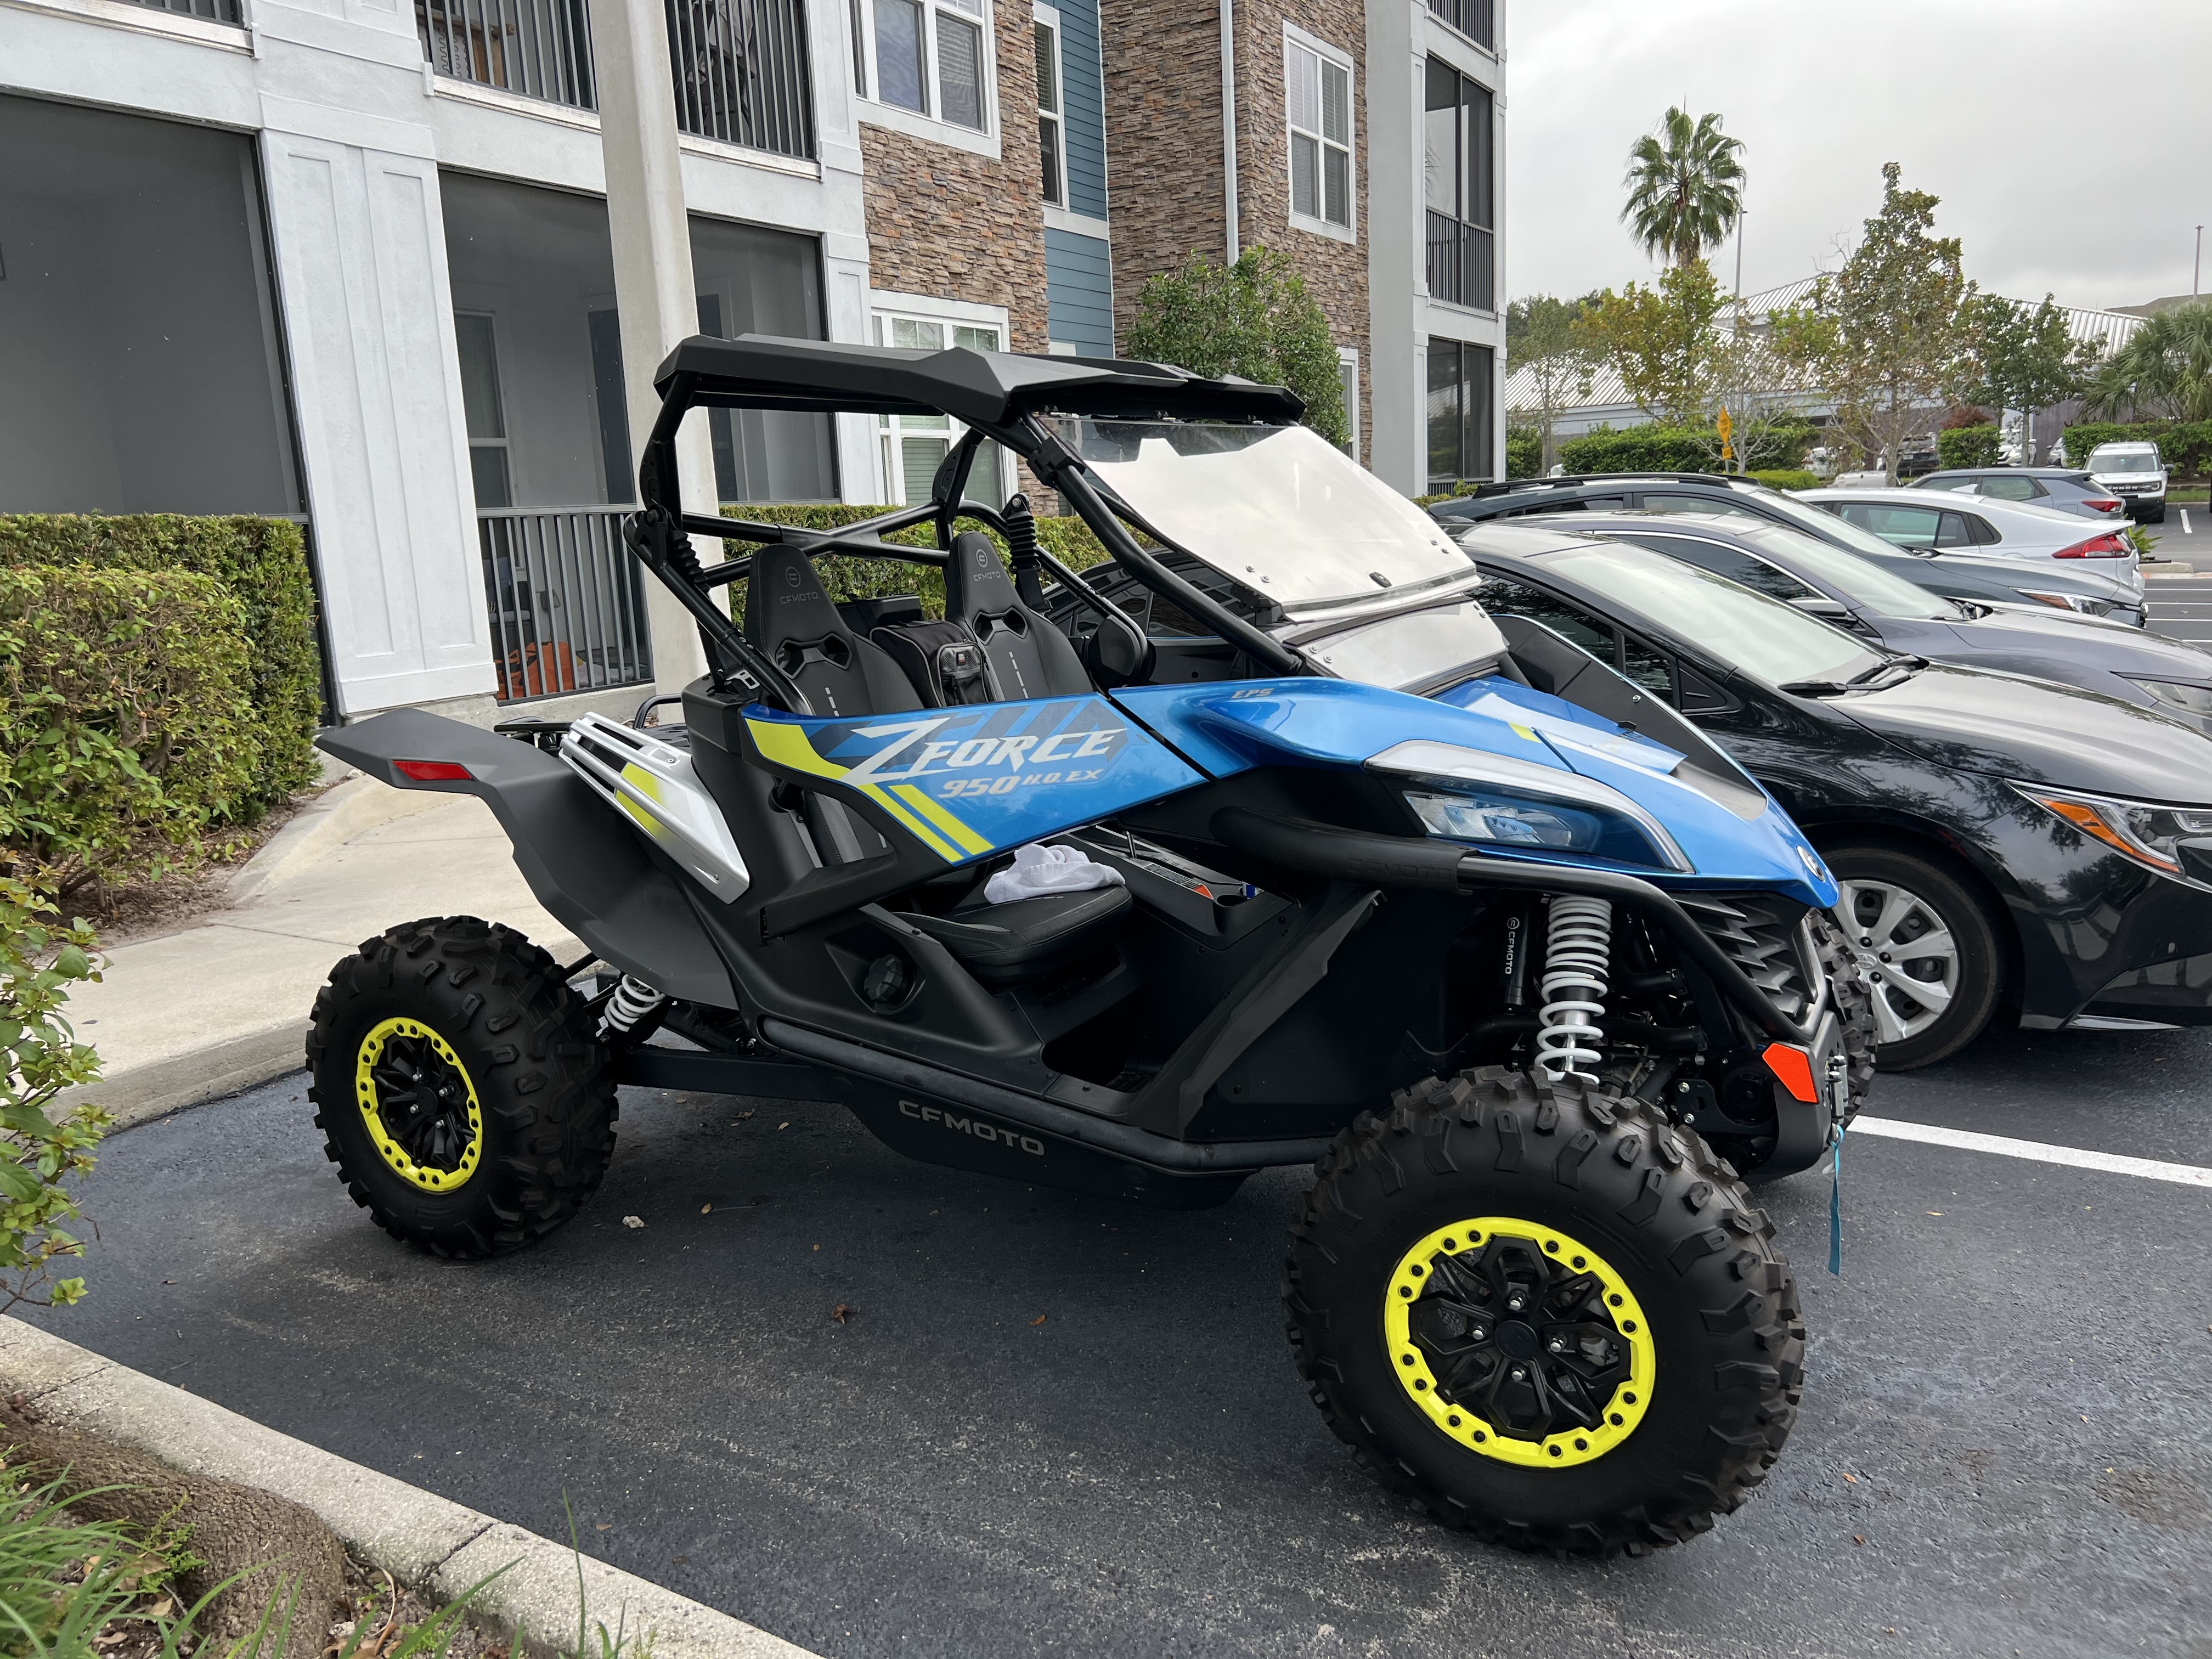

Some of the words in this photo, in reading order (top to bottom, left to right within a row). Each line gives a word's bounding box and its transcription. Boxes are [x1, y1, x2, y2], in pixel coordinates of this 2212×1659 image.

[973, 571, 1001, 582] CFMOTO
[780, 591, 819, 604] CFMOTO
[1231, 688, 1276, 699] EPS
[937, 776, 1022, 798] 950
[1022, 772, 1062, 785] H.O.
[1065, 769, 1105, 782] EX
[1346, 858, 1452, 883] CFMOTO
[1505, 932, 1515, 974] CFMOTO
[899, 1100, 1045, 1156] CFMOTO
